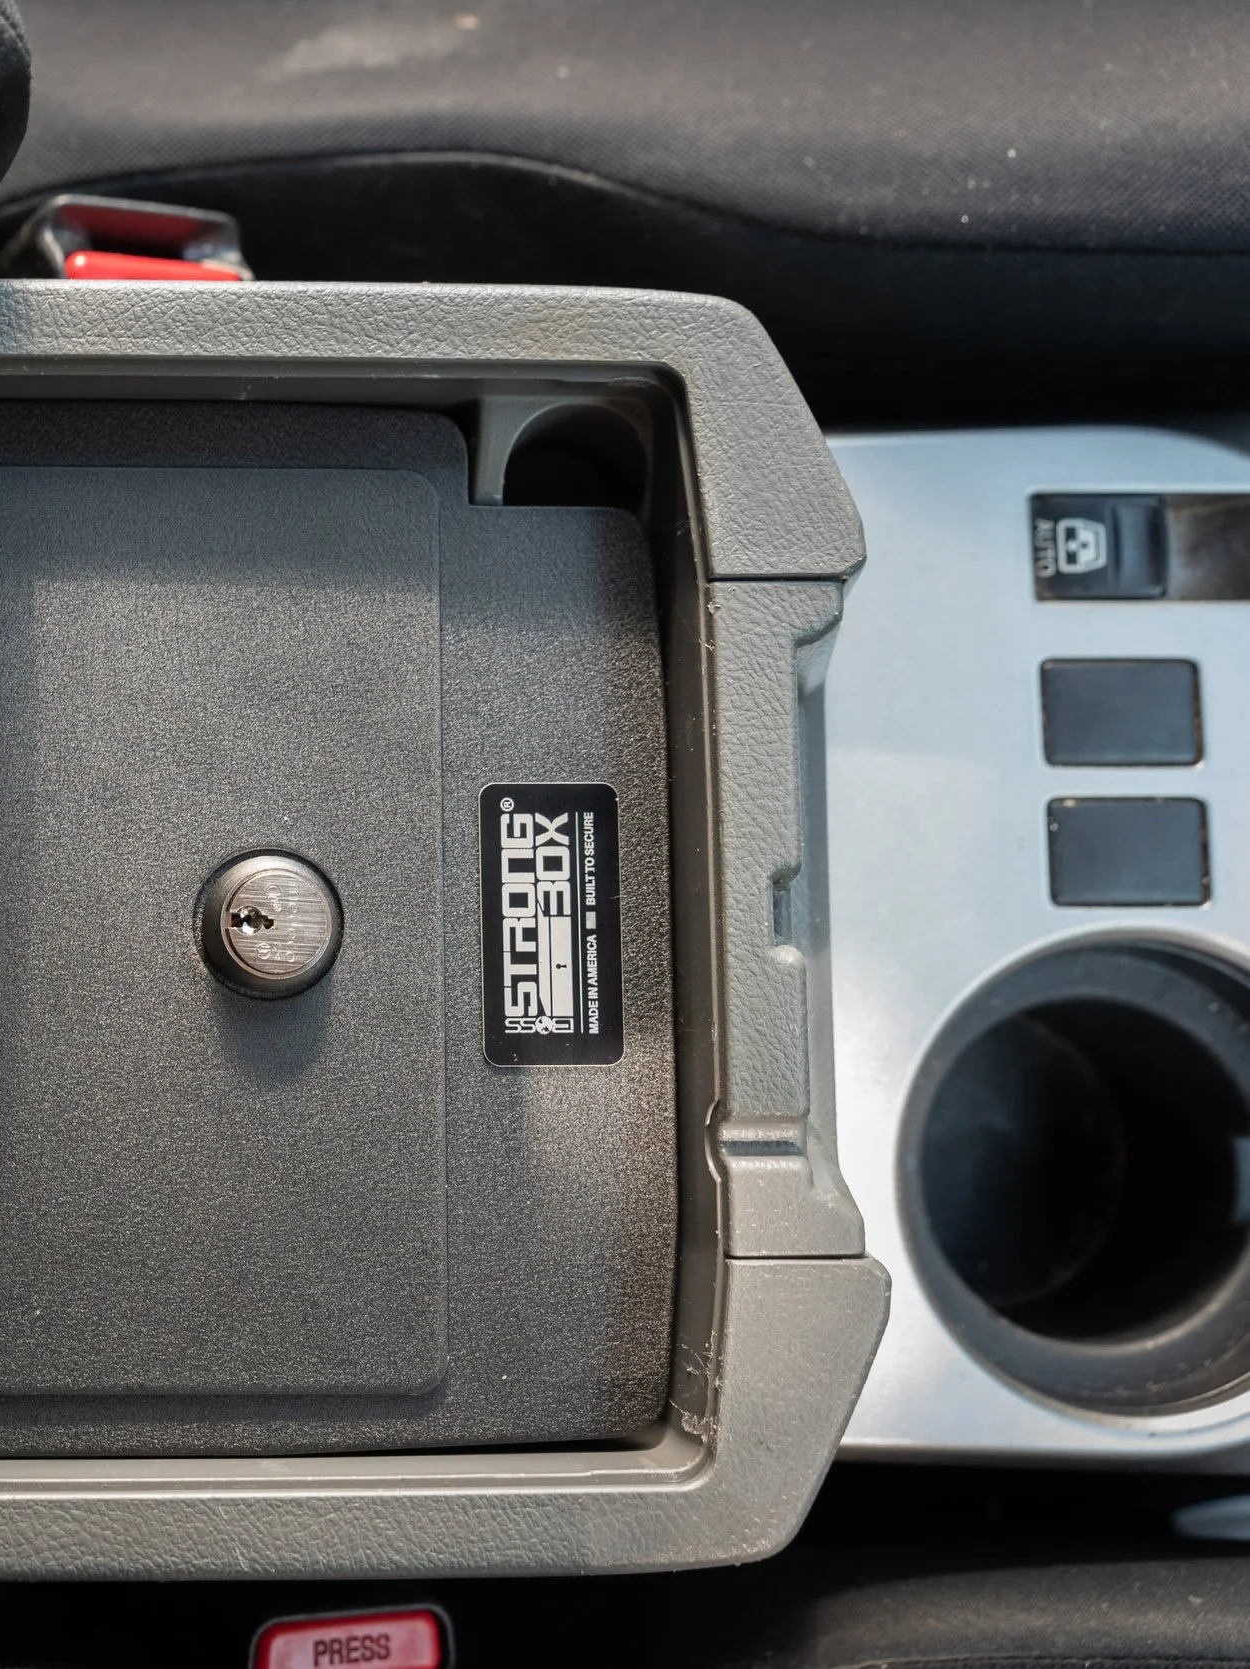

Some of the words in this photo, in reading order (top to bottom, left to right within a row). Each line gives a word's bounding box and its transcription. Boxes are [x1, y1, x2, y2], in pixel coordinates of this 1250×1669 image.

[1034, 518, 1057, 578] AUTO
[584, 812, 595, 856] SECURE
[585, 857, 596, 871] TO
[585, 873, 596, 905] BUILT
[586, 934, 598, 986] AMERICA
[587, 986, 598, 999] IN
[587, 1000, 599, 1034] MADE
[313, 1632, 390, 1667] PRESS
